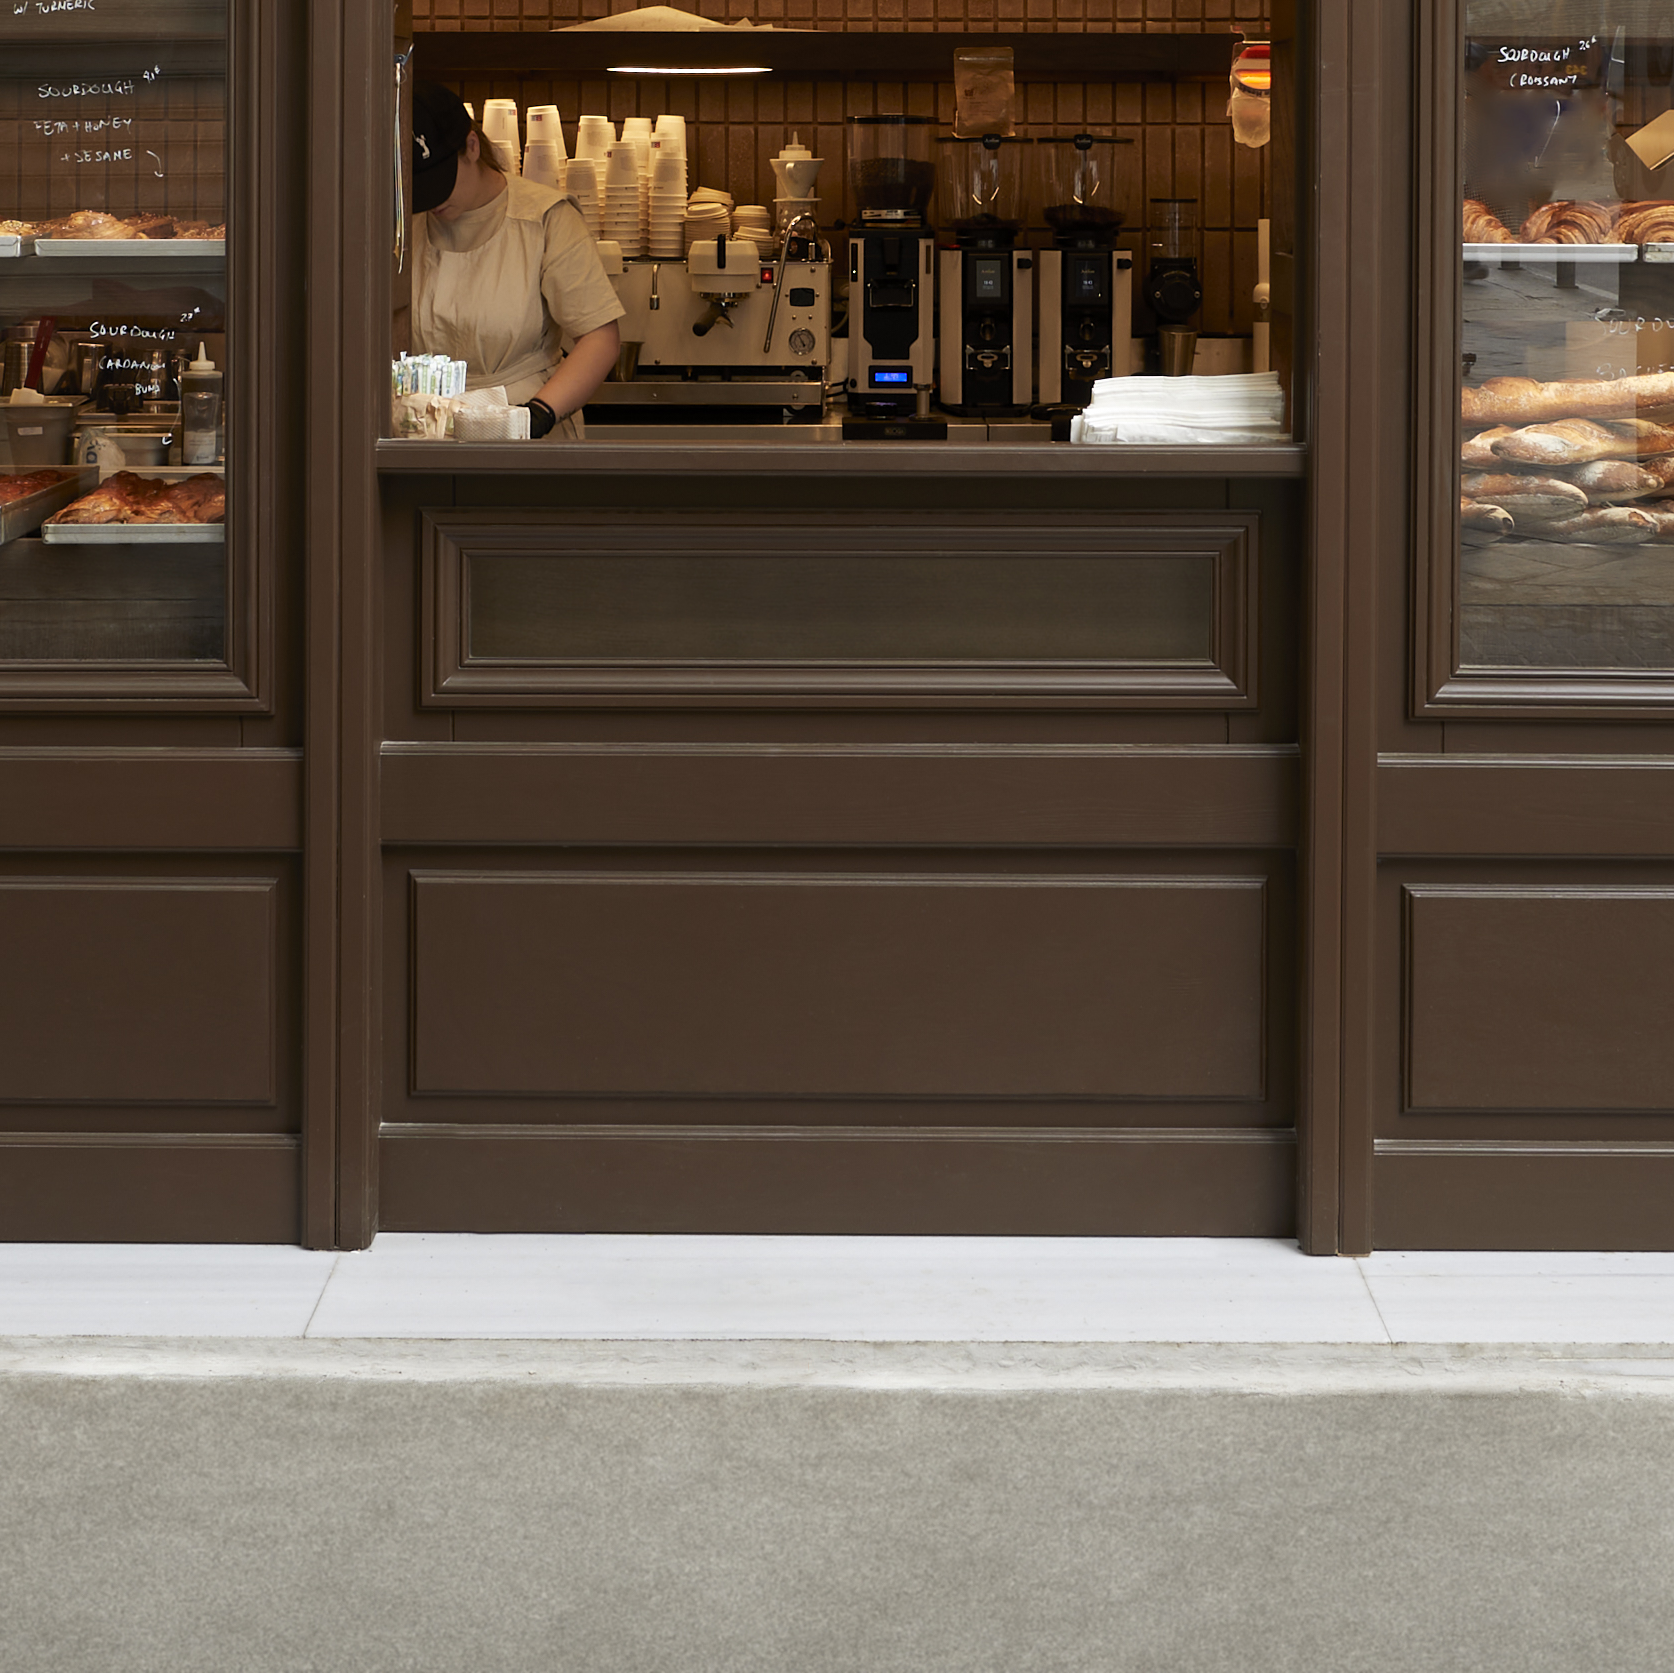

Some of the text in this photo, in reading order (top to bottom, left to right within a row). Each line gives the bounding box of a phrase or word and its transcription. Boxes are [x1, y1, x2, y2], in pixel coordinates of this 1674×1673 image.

[1497, 45, 1571, 63] SOURDOUGH
[37, 79, 135, 99] SOURDOUGH
[33, 119, 70, 137] FETA
[83, 116, 133, 135] HONEY
[89, 320, 176, 341] SOURDOUGH
